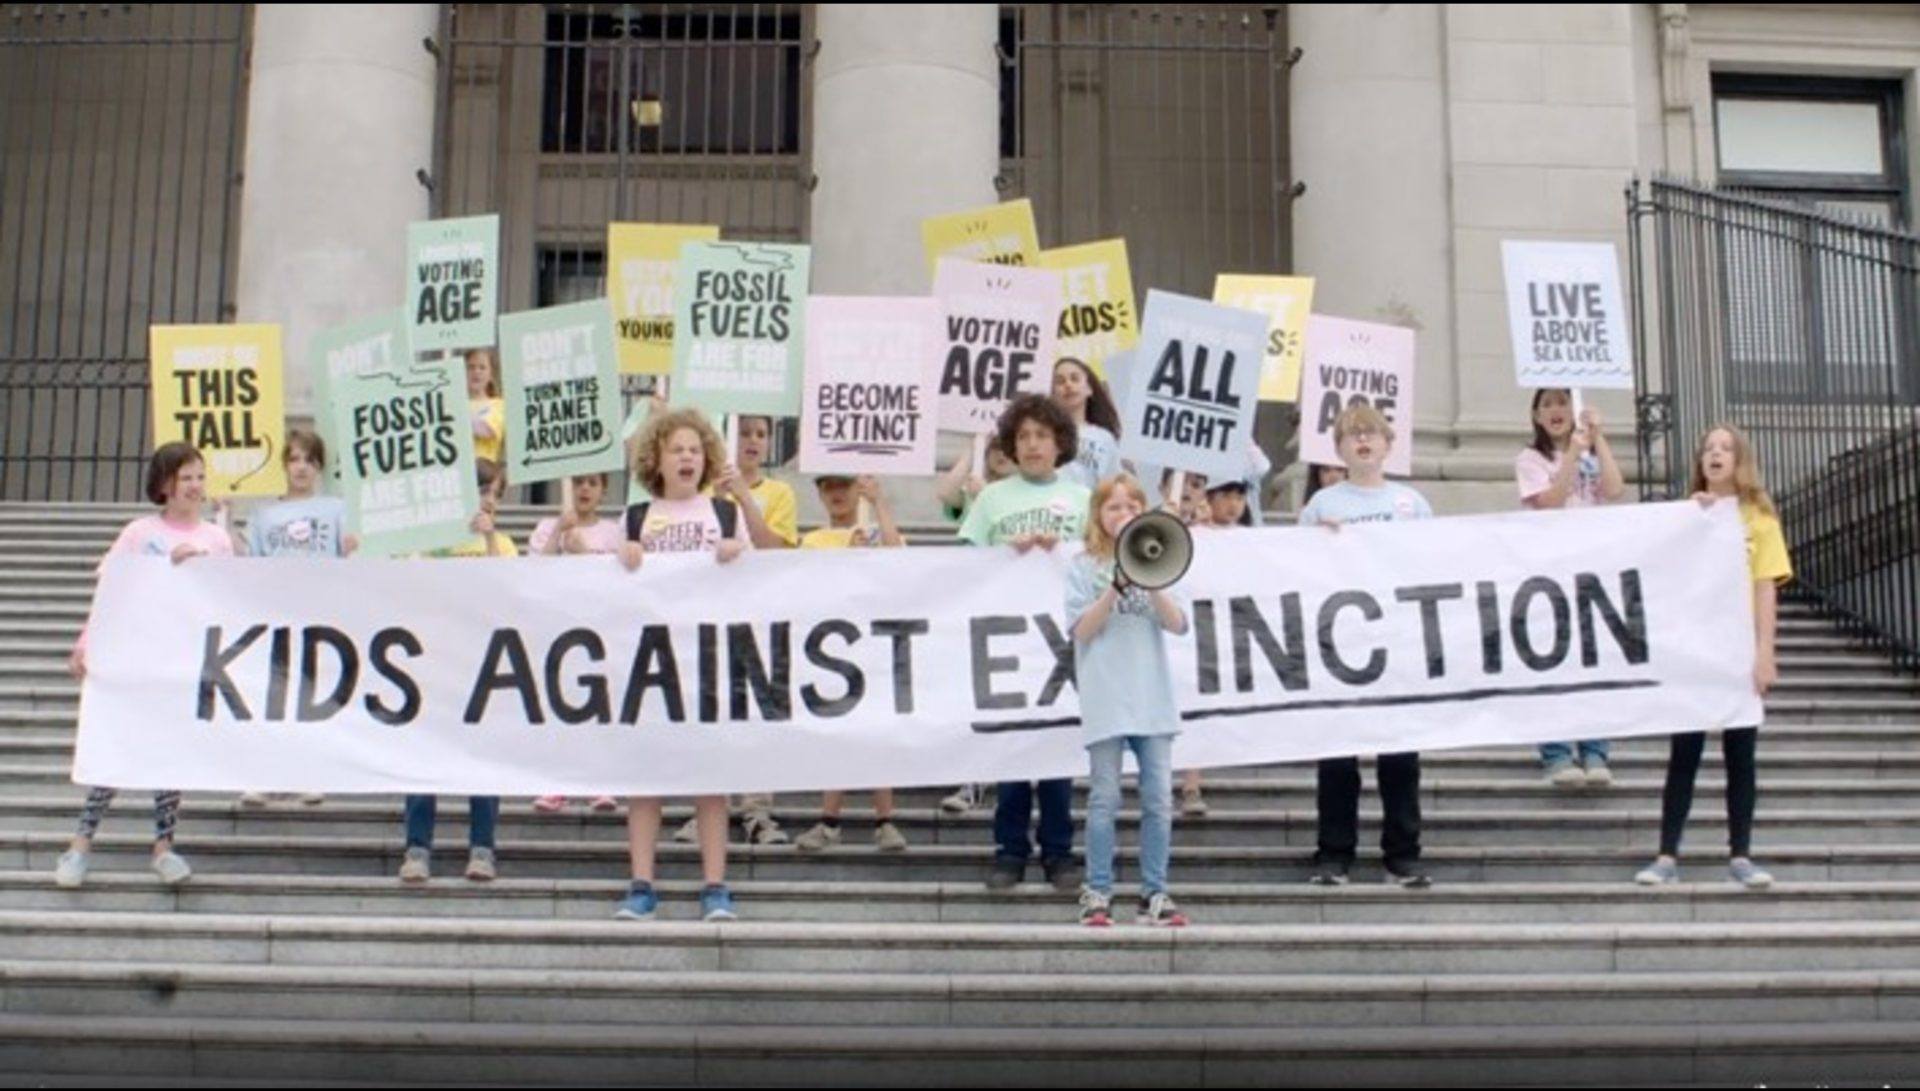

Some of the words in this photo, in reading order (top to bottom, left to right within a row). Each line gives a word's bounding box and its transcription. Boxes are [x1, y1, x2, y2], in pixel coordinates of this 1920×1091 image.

[417, 257, 484, 284] VOTING
[696, 269, 792, 304] FOSSIL
[416, 281, 483, 326] AGE
[1528, 282, 1607, 318] LIVE
[618, 320, 673, 340] YOUNG
[690, 301, 790, 343] FUELS
[946, 315, 1040, 349] VOTING
[1532, 319, 1608, 346] ABOVE
[1534, 344, 1562, 362] SEA
[1567, 345, 1613, 363] LEVEL
[173, 367, 259, 407] THIS
[523, 384, 562, 403] TURN
[565, 377, 600, 397] THIS
[939, 345, 1036, 400] AGE
[1146, 338, 1241, 408] ALL
[1318, 363, 1400, 397] VOTING
[353, 391, 455, 439] FOSSIL
[524, 395, 599, 426] PLANET
[817, 383, 920, 412] BECOME
[174, 412, 261, 450] TALL
[524, 419, 604, 452] AROUND
[818, 412, 922, 443] EXTINCT
[1141, 404, 1238, 453] RIGHT
[353, 426, 458, 479] FUELS
[195, 624, 423, 725] KIDS
[462, 617, 930, 727] AGAINST
[969, 567, 1651, 710] EXINCTION
